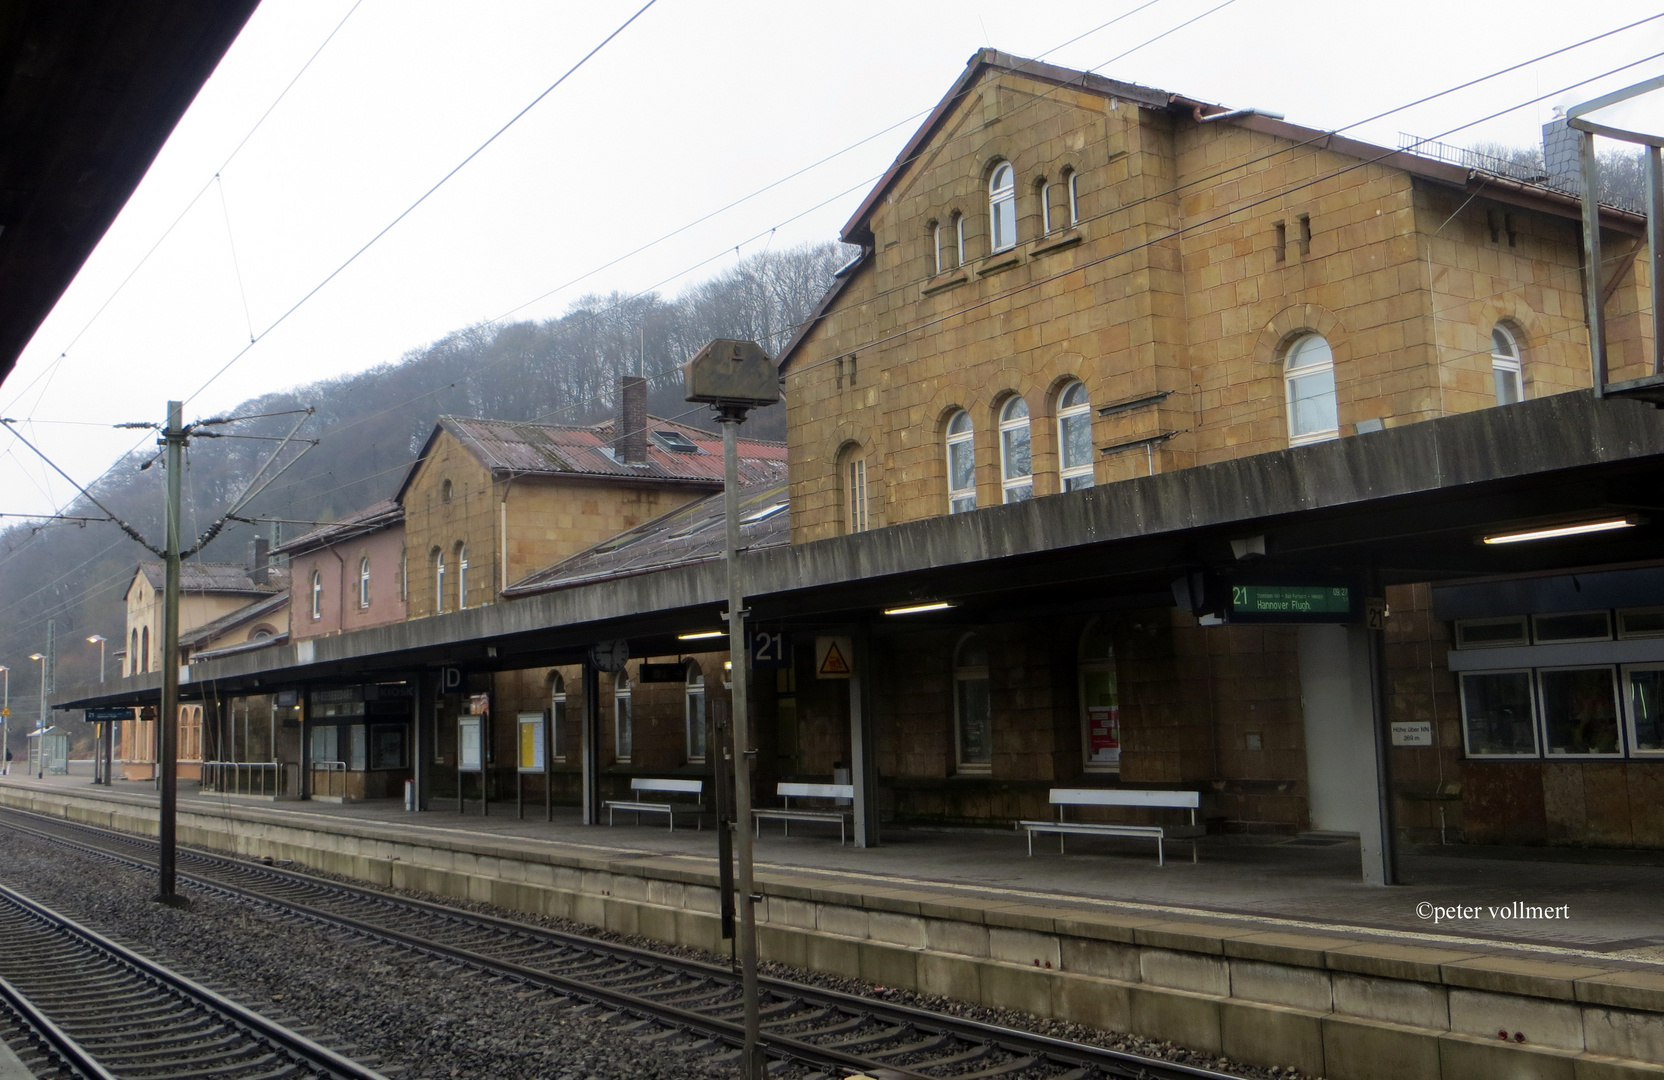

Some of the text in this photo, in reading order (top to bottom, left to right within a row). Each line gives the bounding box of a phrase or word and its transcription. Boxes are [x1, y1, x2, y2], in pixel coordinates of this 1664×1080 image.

[1232, 586, 1248, 605] 21
[1332, 588, 1348, 597] 09:27
[1257, 600, 1289, 610] Hannover
[1369, 608, 1383, 628] 21
[755, 632, 783, 661] 21
[446, 667, 461, 688] D
[379, 686, 415, 697] KIOSK
